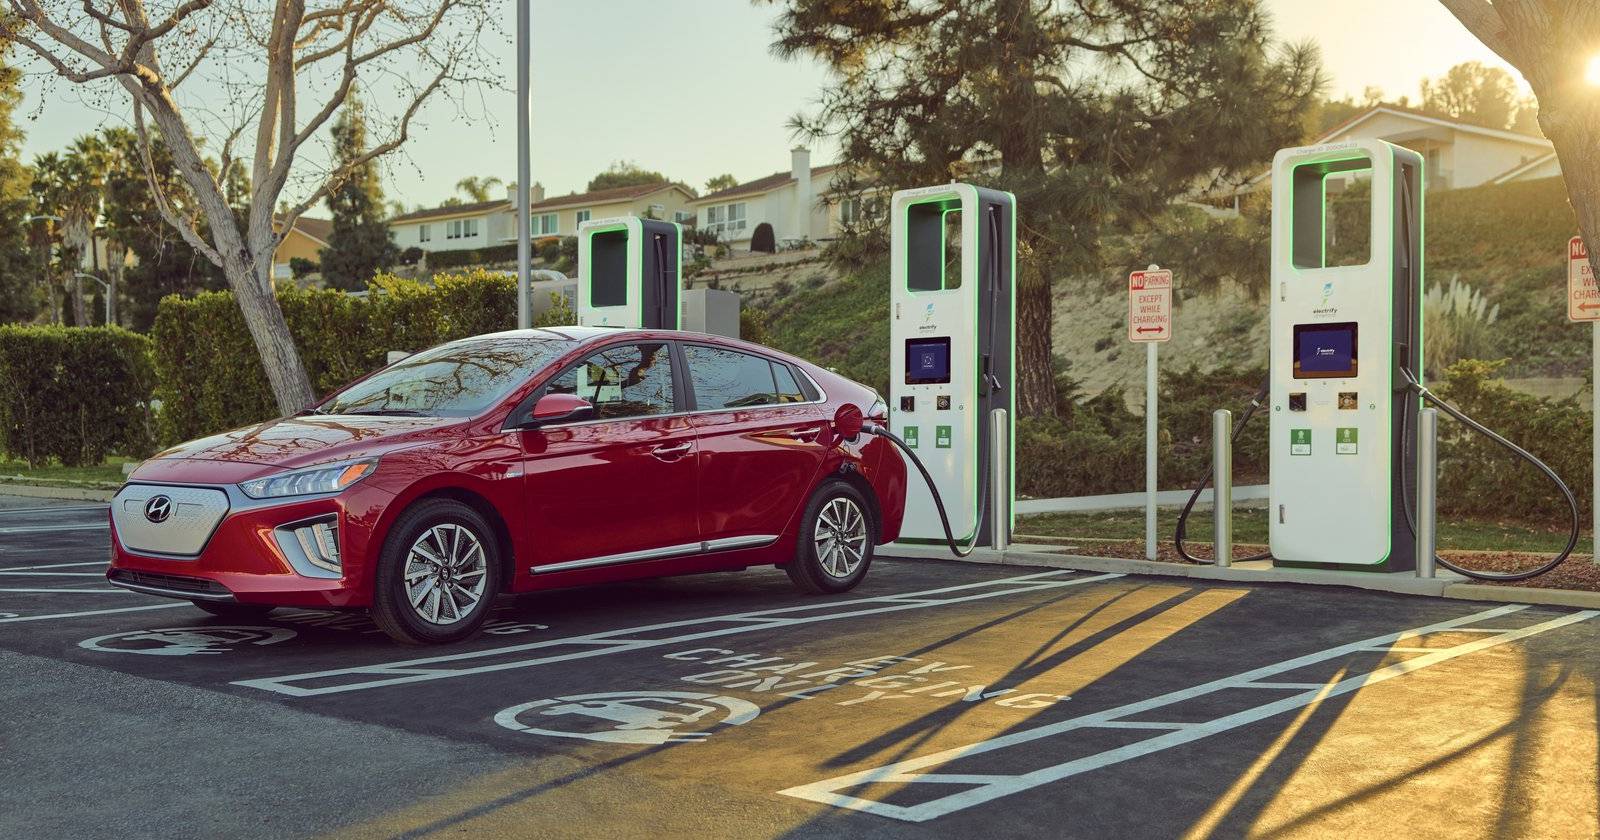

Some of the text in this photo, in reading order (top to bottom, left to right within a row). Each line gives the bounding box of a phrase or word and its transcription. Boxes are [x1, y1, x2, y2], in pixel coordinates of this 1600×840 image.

[1572, 241, 1586, 256] NO
[1132, 275, 1169, 288] NO PARKING
[1139, 295, 1162, 304] EXCEPT
[1141, 305, 1161, 313] WHILE
[1133, 315, 1168, 324] CHARGING
[662, 648, 1072, 708] CHARGING
[680, 670, 912, 706] ONLY
